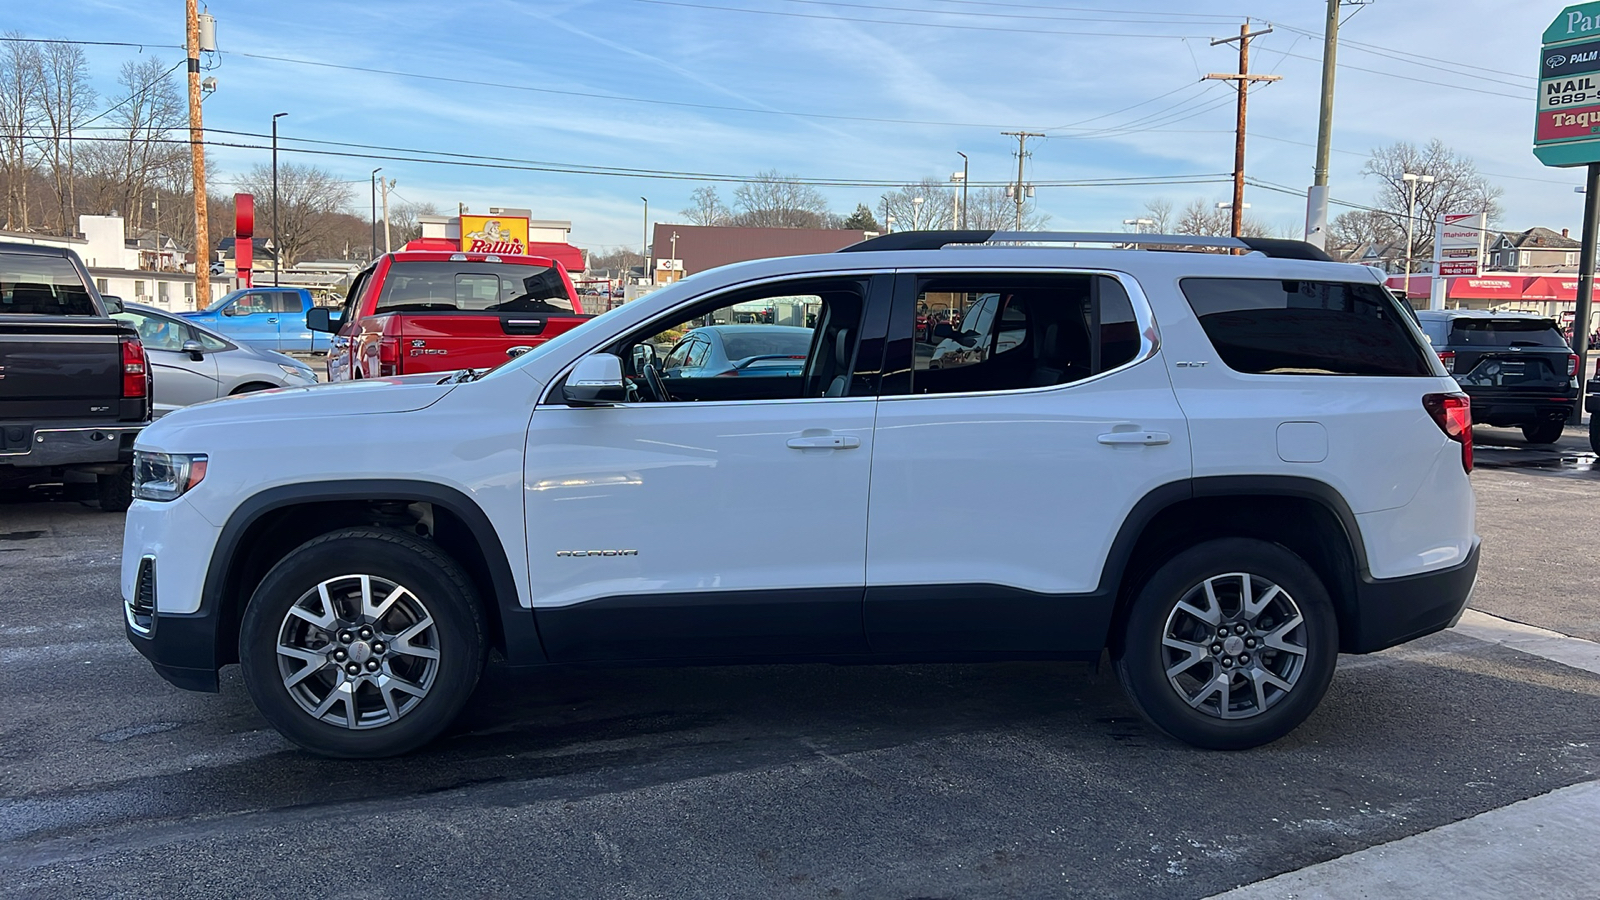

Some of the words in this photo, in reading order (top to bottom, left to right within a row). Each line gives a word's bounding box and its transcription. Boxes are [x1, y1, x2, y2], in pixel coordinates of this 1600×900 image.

[1570, 51, 1598, 64] PALM
[1547, 78, 1596, 95] NAIL
[1552, 111, 1600, 128] Taqu
[468, 237, 524, 255] Rally's
[556, 549, 638, 557] ACADIA
